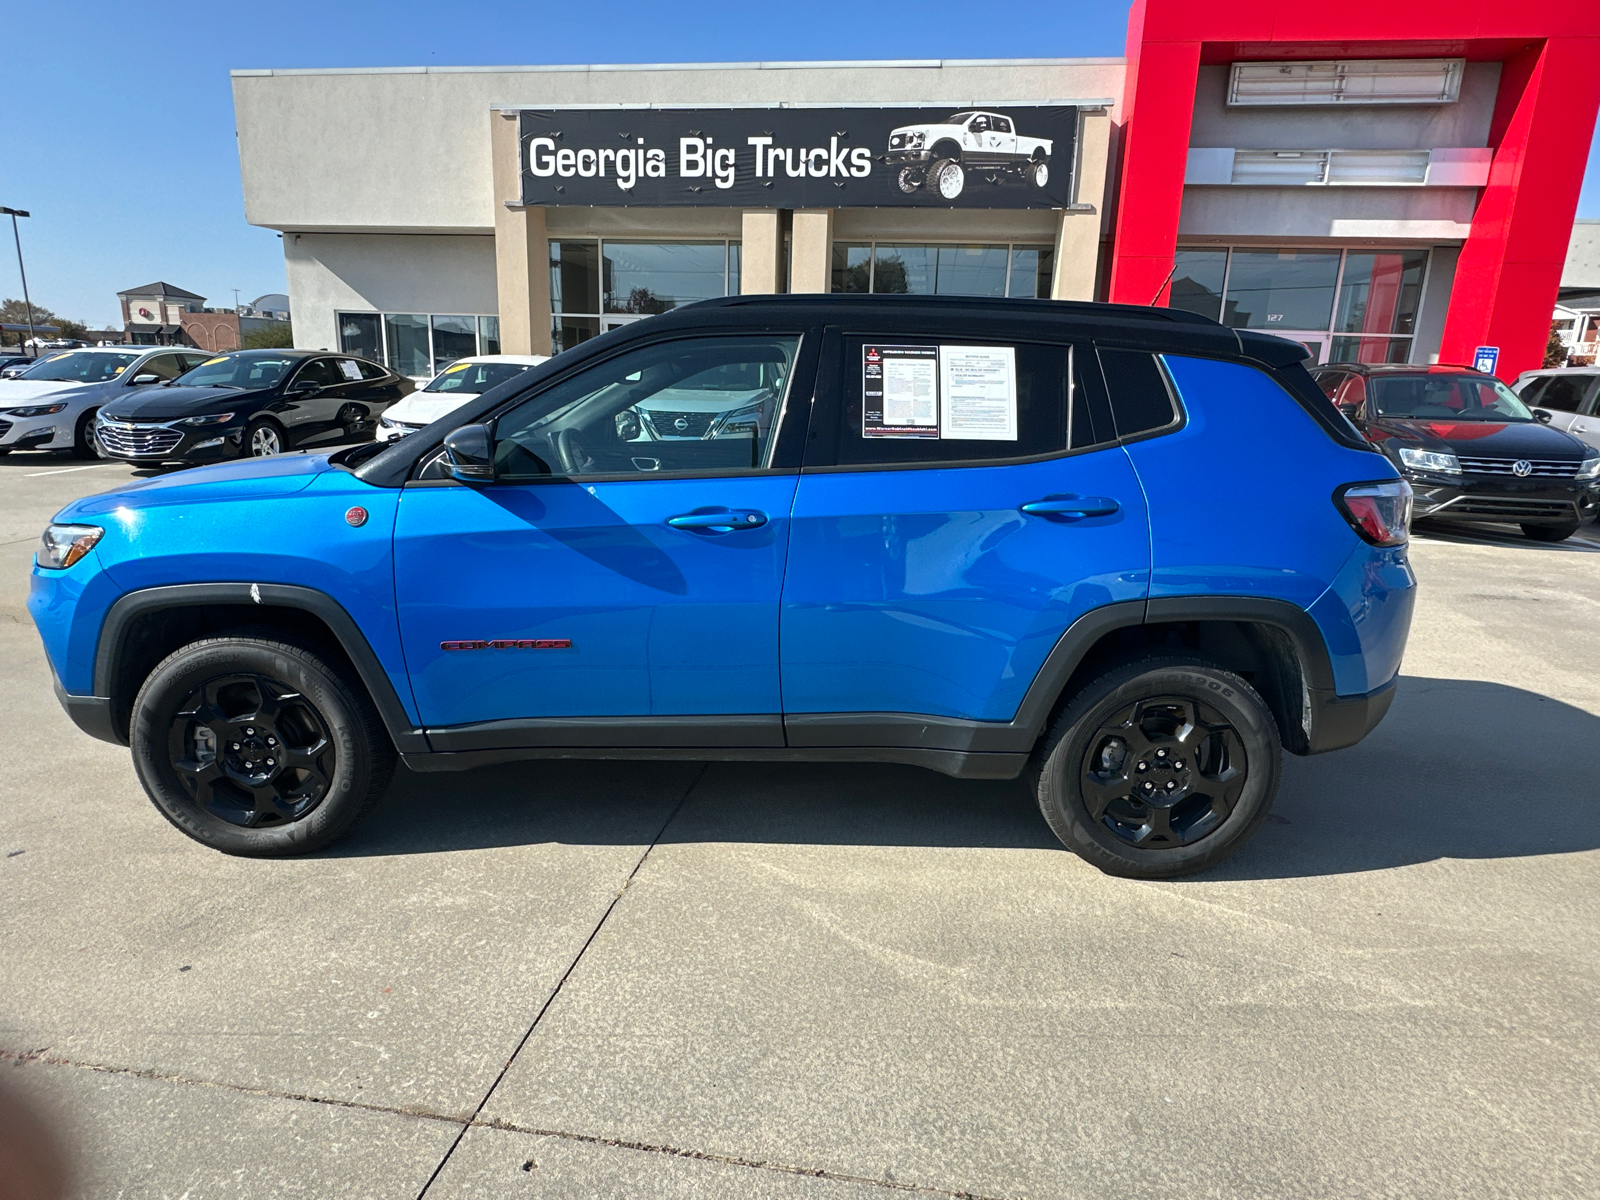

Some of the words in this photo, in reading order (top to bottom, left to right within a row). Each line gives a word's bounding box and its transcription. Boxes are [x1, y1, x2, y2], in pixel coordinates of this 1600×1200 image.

[529, 137, 666, 190] Georgia
[679, 137, 736, 189] Big
[747, 136, 872, 178] Trucks
[440, 639, 571, 650] COMPASS
